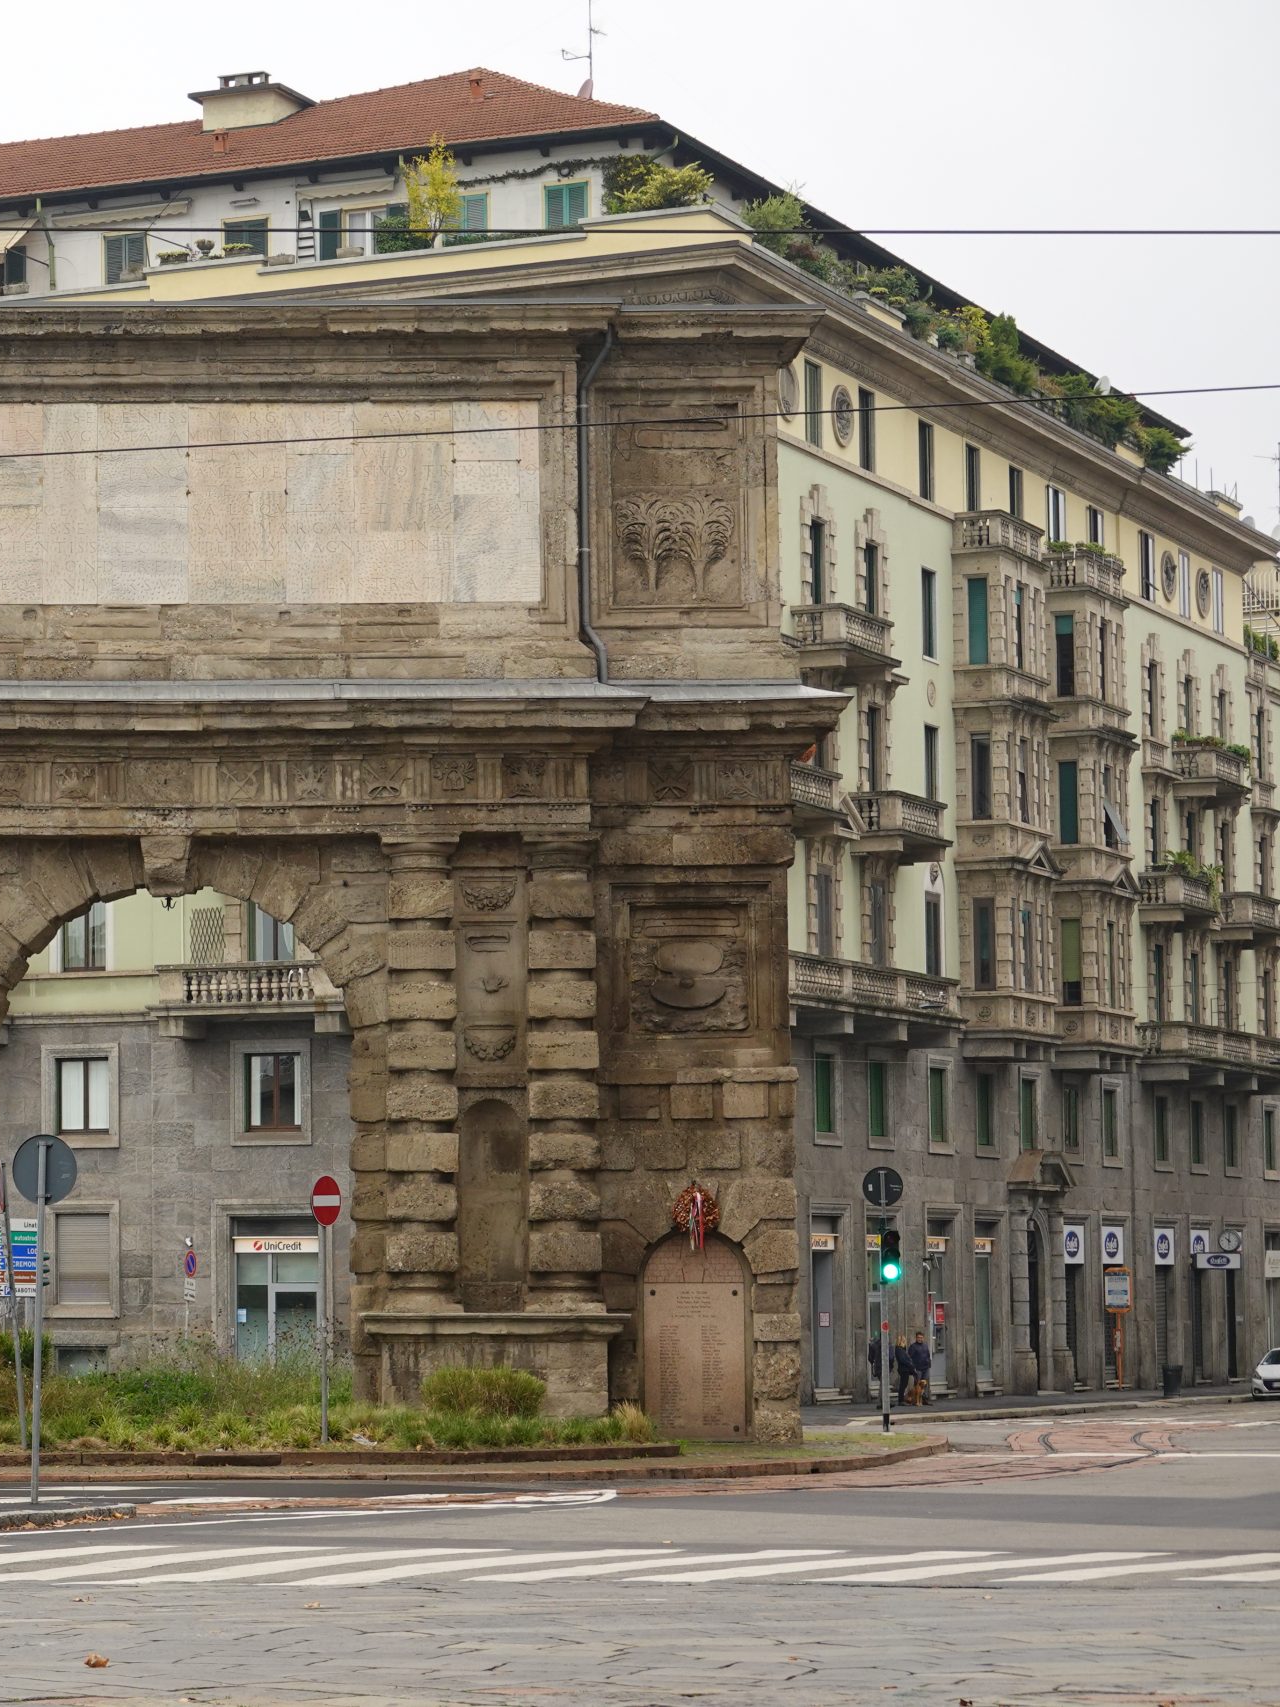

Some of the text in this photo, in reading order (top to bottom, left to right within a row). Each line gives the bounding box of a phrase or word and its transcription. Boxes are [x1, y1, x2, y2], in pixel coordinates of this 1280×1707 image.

[23, 1221, 37, 1229] Linat
[14, 1234, 37, 1242] autostrad
[264, 1241, 303, 1251] UniCredit
